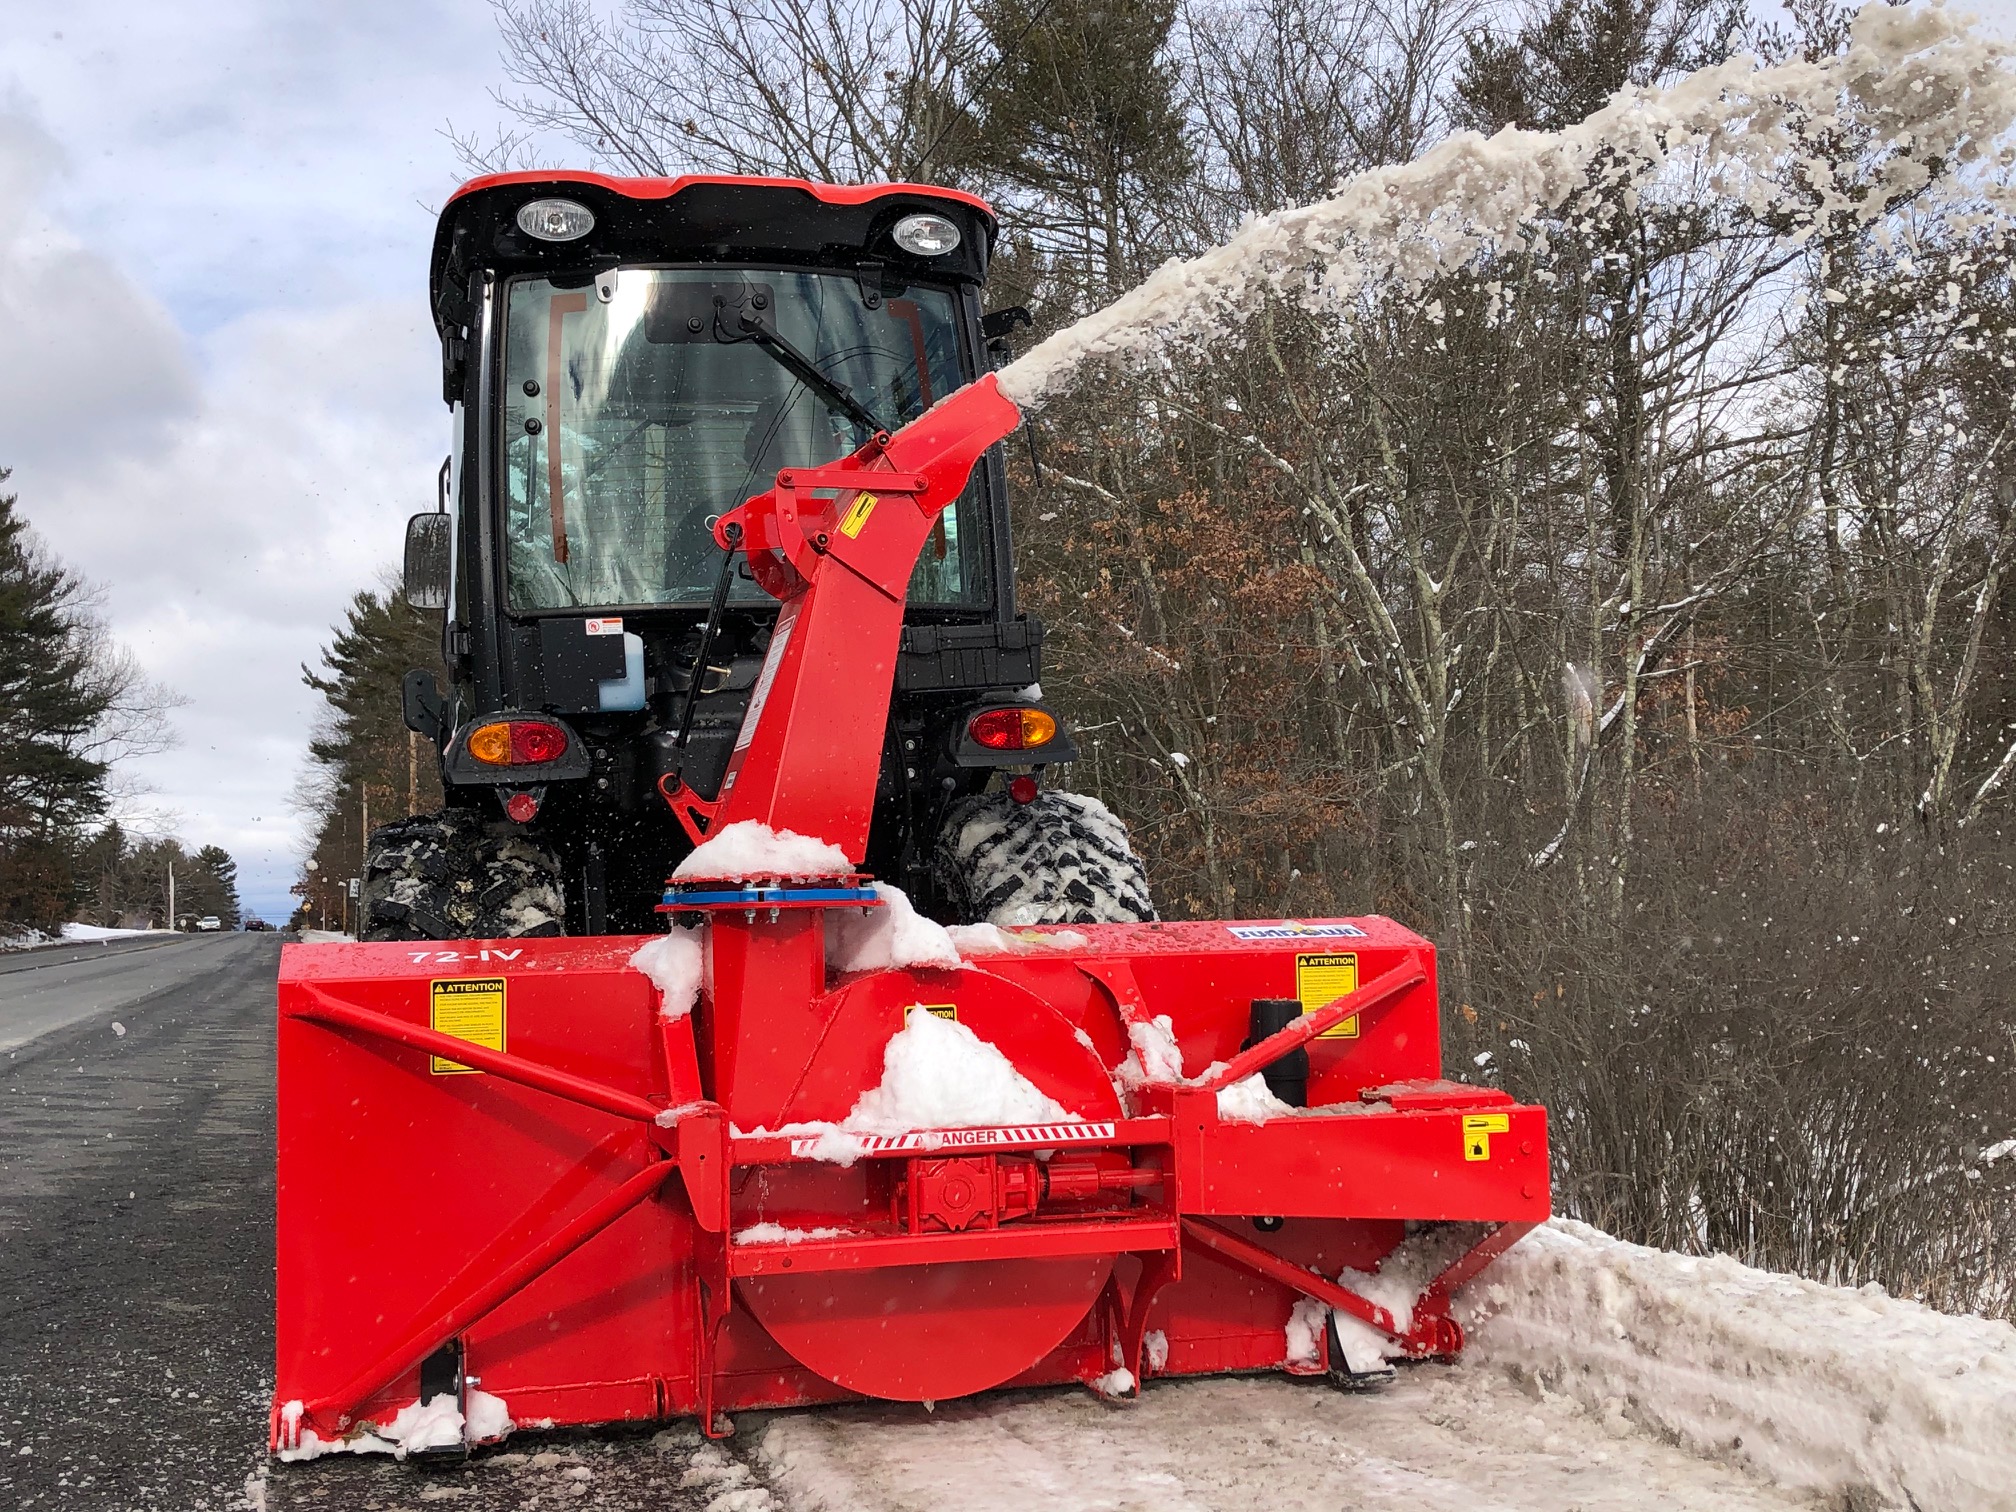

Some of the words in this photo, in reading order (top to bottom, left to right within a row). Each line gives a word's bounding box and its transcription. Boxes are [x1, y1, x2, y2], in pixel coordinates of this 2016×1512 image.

[407, 949, 524, 964] 72-IV
[1308, 957, 1355, 966] ATTENTION
[446, 982, 503, 993] ATTENTION
[928, 1130, 998, 1146] ANGER
